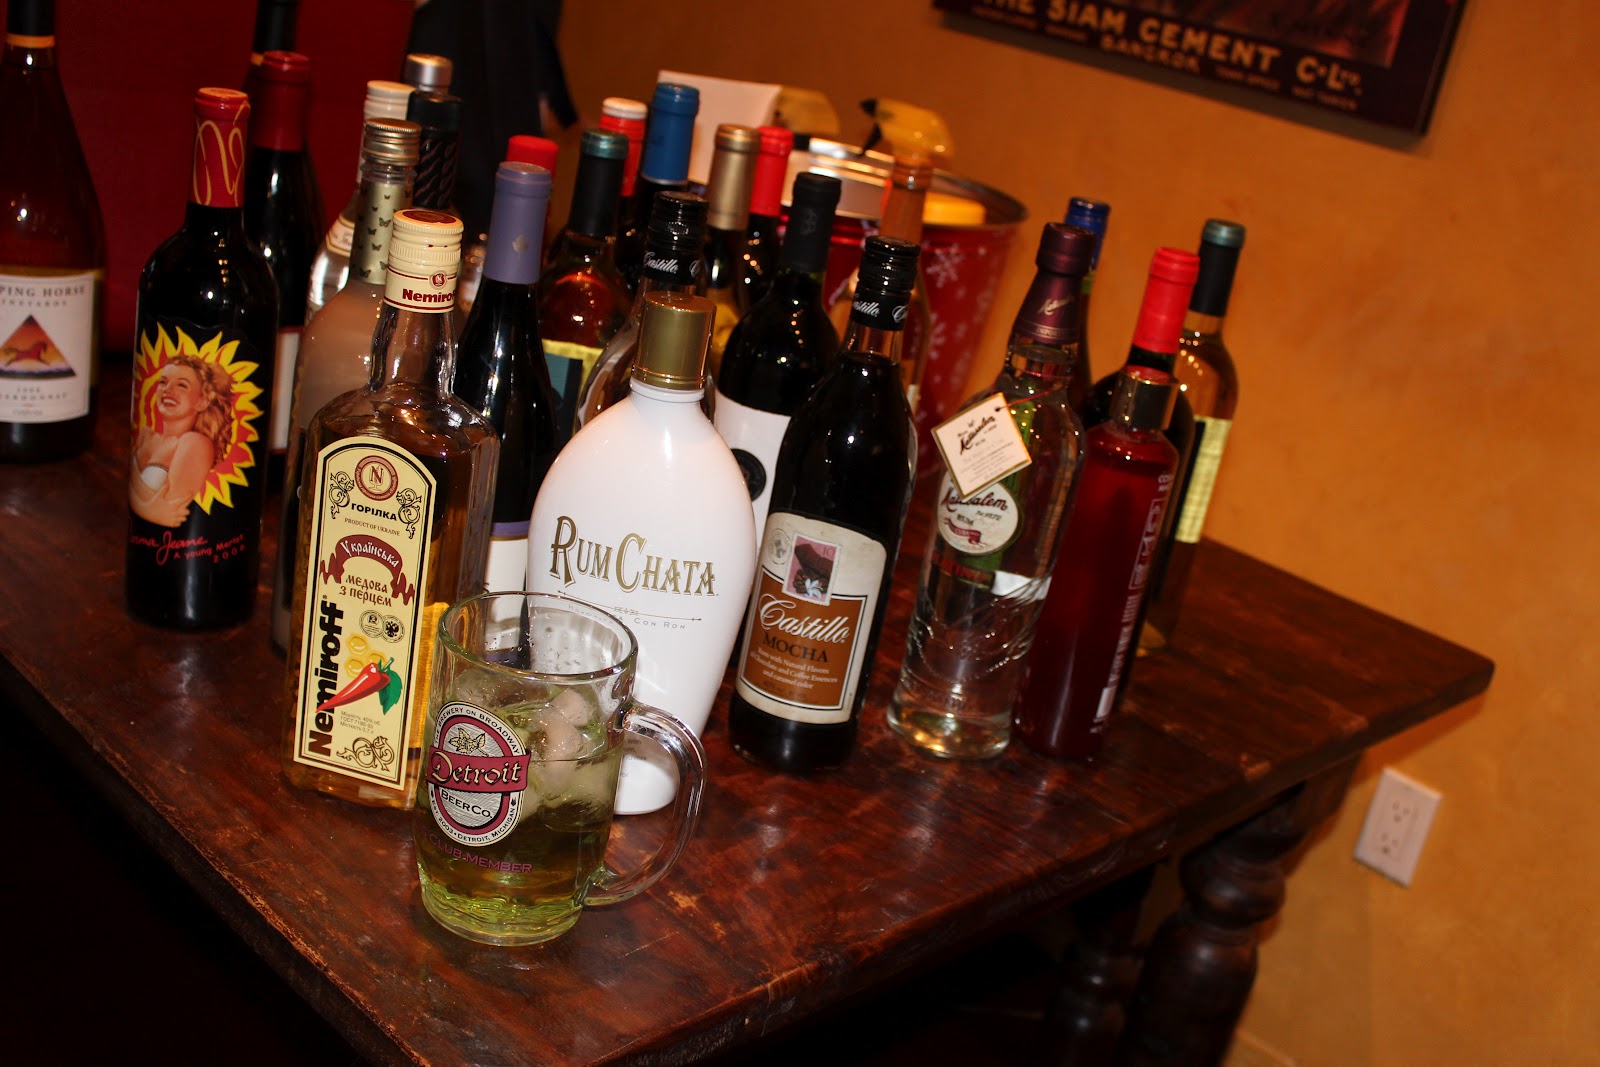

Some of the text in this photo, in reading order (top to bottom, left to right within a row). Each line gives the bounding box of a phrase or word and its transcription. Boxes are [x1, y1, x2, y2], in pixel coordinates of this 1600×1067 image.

[1047, 0, 1125, 35] SIAM
[1138, 18, 1280, 72] CEMENT
[43, 284, 86, 298] HORSE
[402, 288, 456, 303] Nemiro
[351, 503, 398, 521] ГОРІЛКА
[344, 517, 369, 529] PRODUCT
[377, 525, 401, 537] UKRAINE
[185, 547, 213, 560] young
[340, 540, 400, 568] Українська
[759, 593, 850, 644] Castillo
[762, 631, 829, 663] MOCHA
[308, 600, 344, 757] Nemiroff
[783, 659, 807, 671] Natural
[807, 665, 830, 674] Flavors
[789, 670, 811, 680] Coffee
[438, 707, 464, 727] BREWERY
[479, 713, 520, 755] BROADWAY
[431, 751, 522, 786] Detroit
[491, 807, 516, 838] MICHIGAN
[429, 833, 533, 872] CLUB MEMBER
